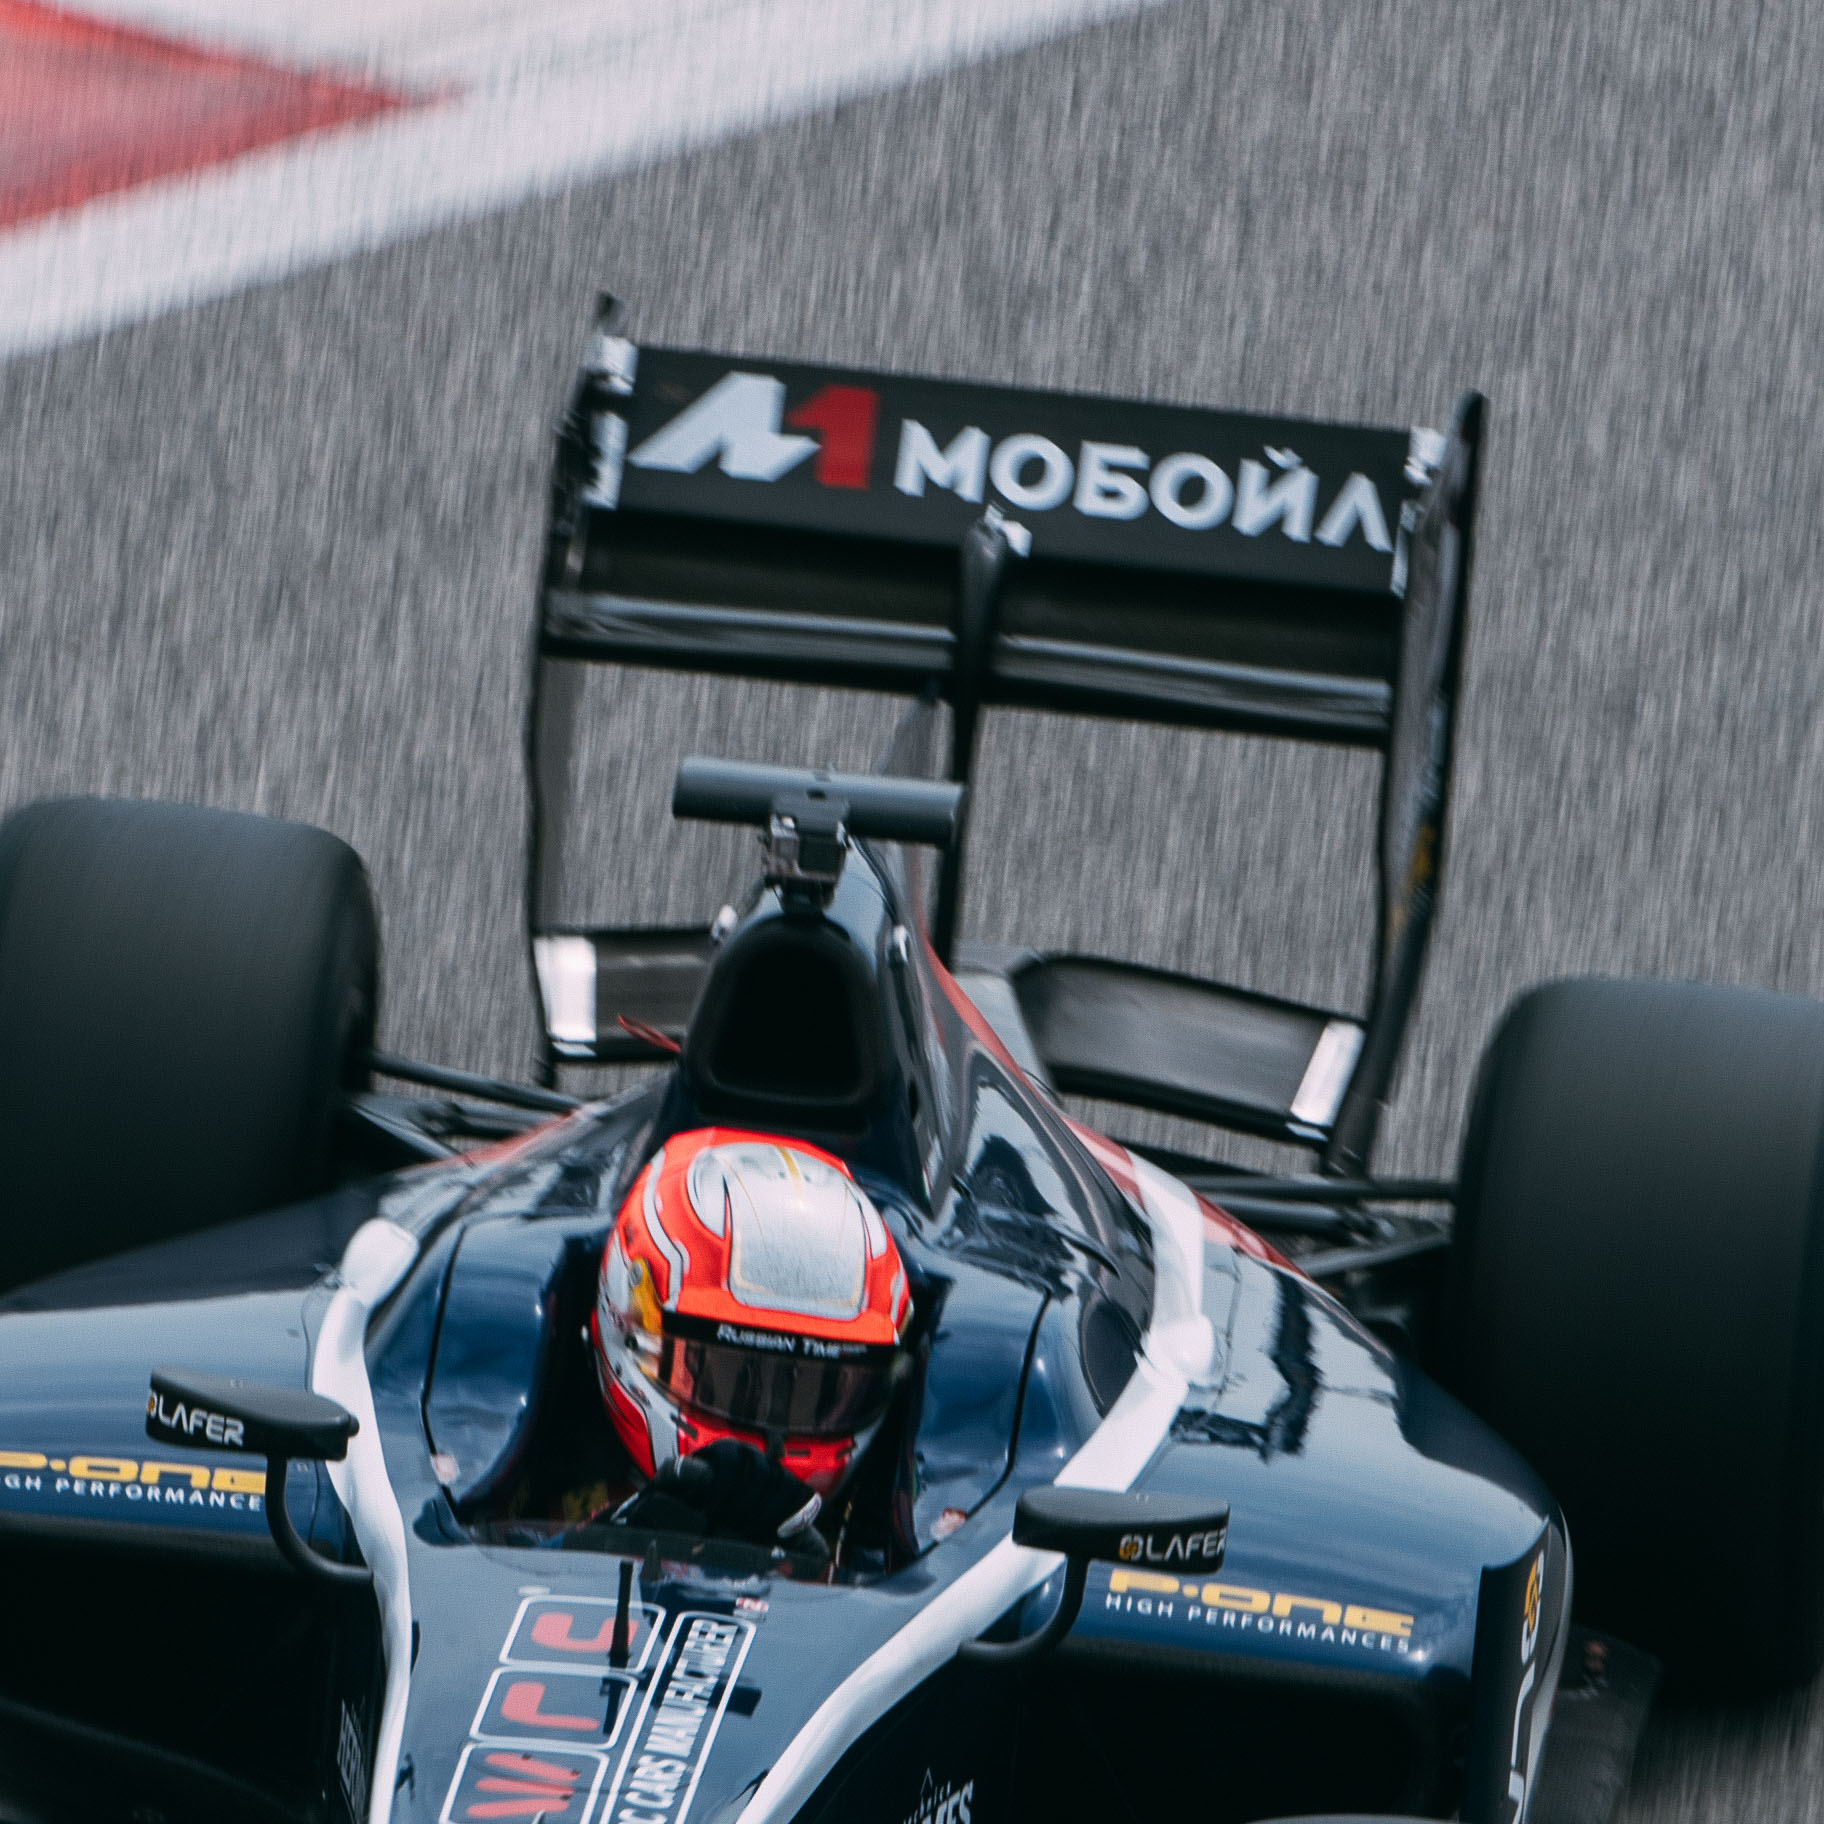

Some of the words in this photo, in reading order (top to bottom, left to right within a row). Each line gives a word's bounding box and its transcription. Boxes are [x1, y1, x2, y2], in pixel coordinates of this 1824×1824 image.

[894, 417, 1395, 554] МОБОЙЛ
[1105, 1592, 1174, 1618] HIGH
[1188, 1605, 1410, 1654] PERFORMANCES
[623, 1754, 688, 1810] CARS
